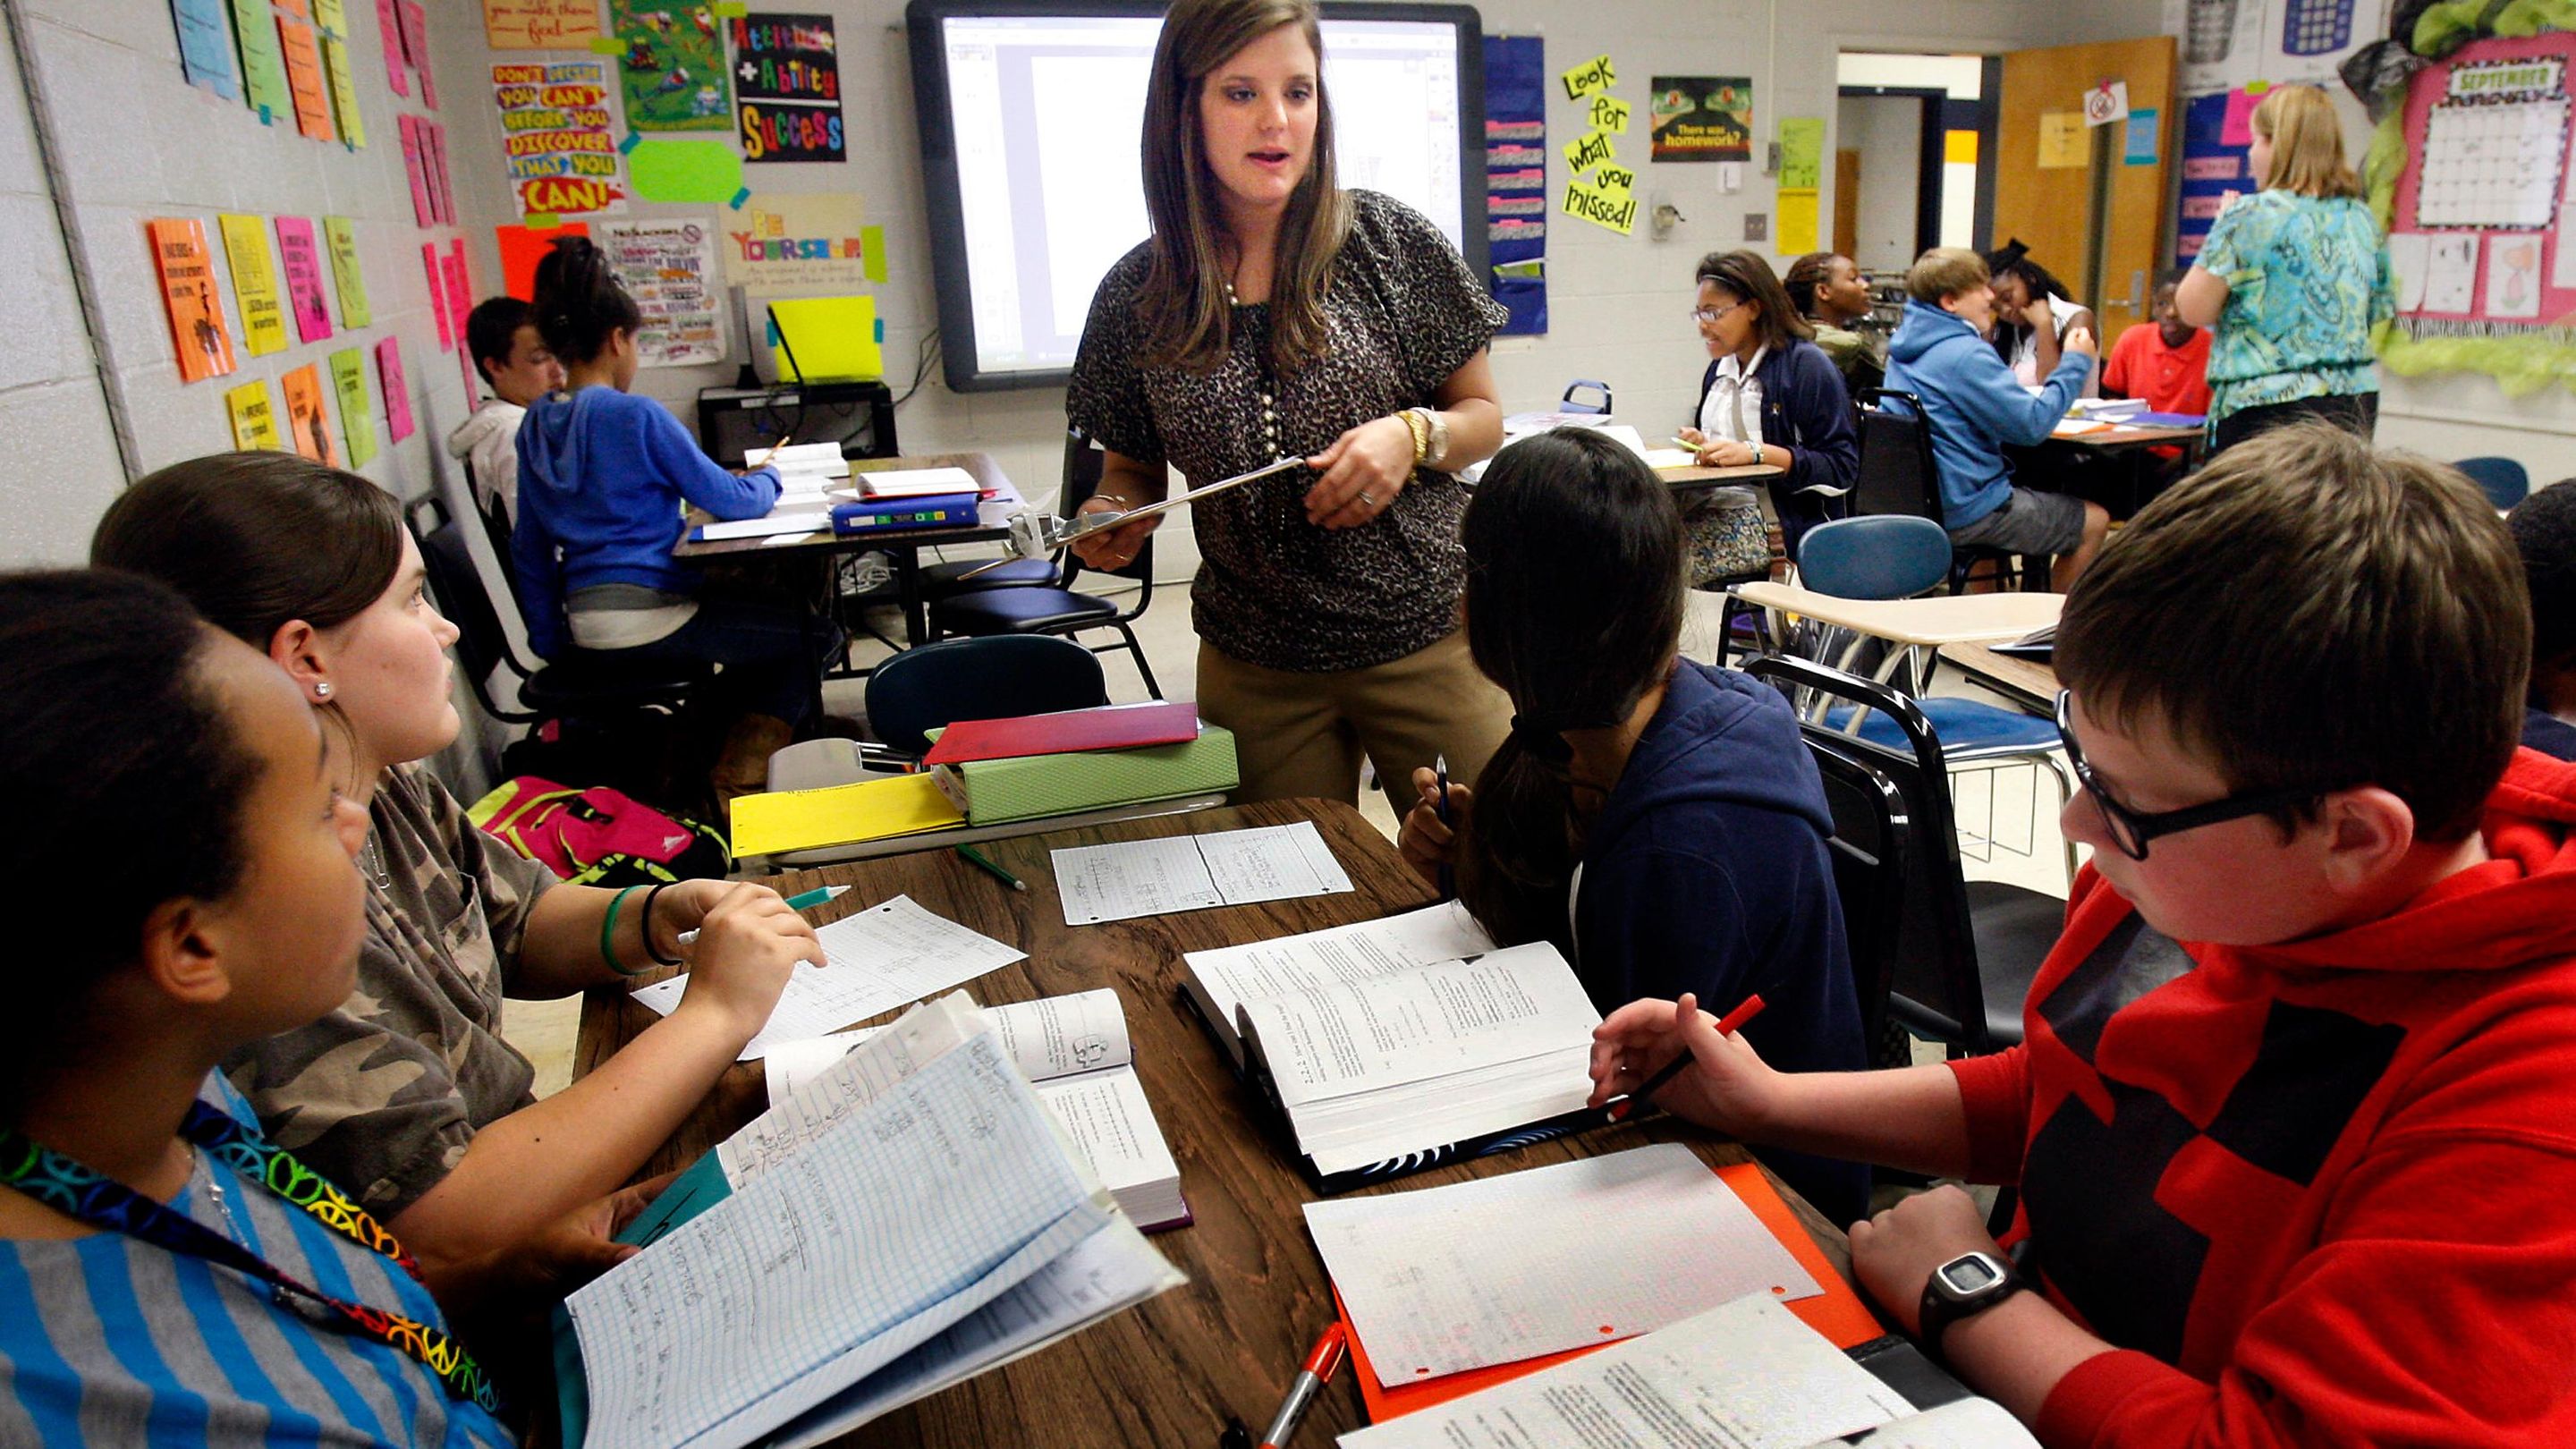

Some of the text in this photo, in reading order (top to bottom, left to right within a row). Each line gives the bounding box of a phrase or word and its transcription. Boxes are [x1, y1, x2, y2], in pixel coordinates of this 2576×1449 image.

[761, 58, 837, 99] Ability
[1563, 56, 1615, 101] Look
[497, 85, 602, 107] YOU CAN'T
[504, 109, 608, 129] BEFORE YOU
[1589, 98, 1628, 130] for
[510, 132, 609, 155] DISCOVER
[742, 105, 843, 159] Success
[1665, 132, 1741, 148] homework?
[513, 154, 616, 175] THAT YOU
[1569, 132, 1610, 172] what
[1597, 168, 1633, 189] you
[527, 178, 608, 212] CAN!
[1564, 184, 1637, 228] missed!
